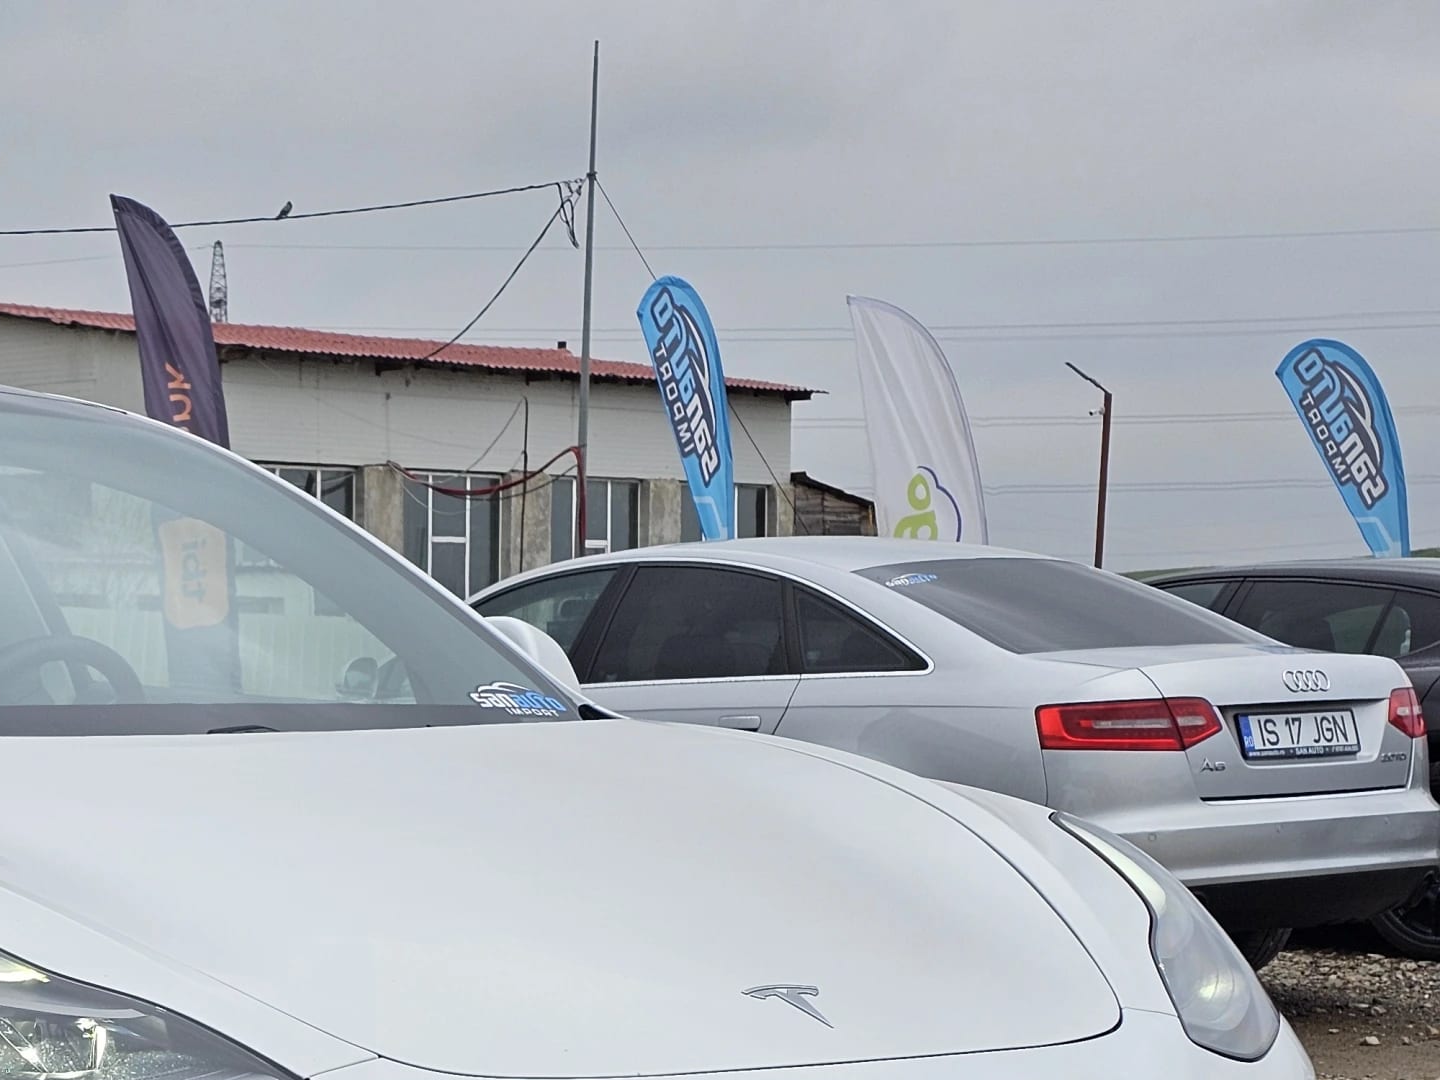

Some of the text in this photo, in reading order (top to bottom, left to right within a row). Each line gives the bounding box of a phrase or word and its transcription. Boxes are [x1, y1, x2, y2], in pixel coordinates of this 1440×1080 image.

[505, 707, 560, 717] IMPORT
[1257, 715, 1349, 747] IS 17 JGN
[1244, 735, 1254, 747] RO
